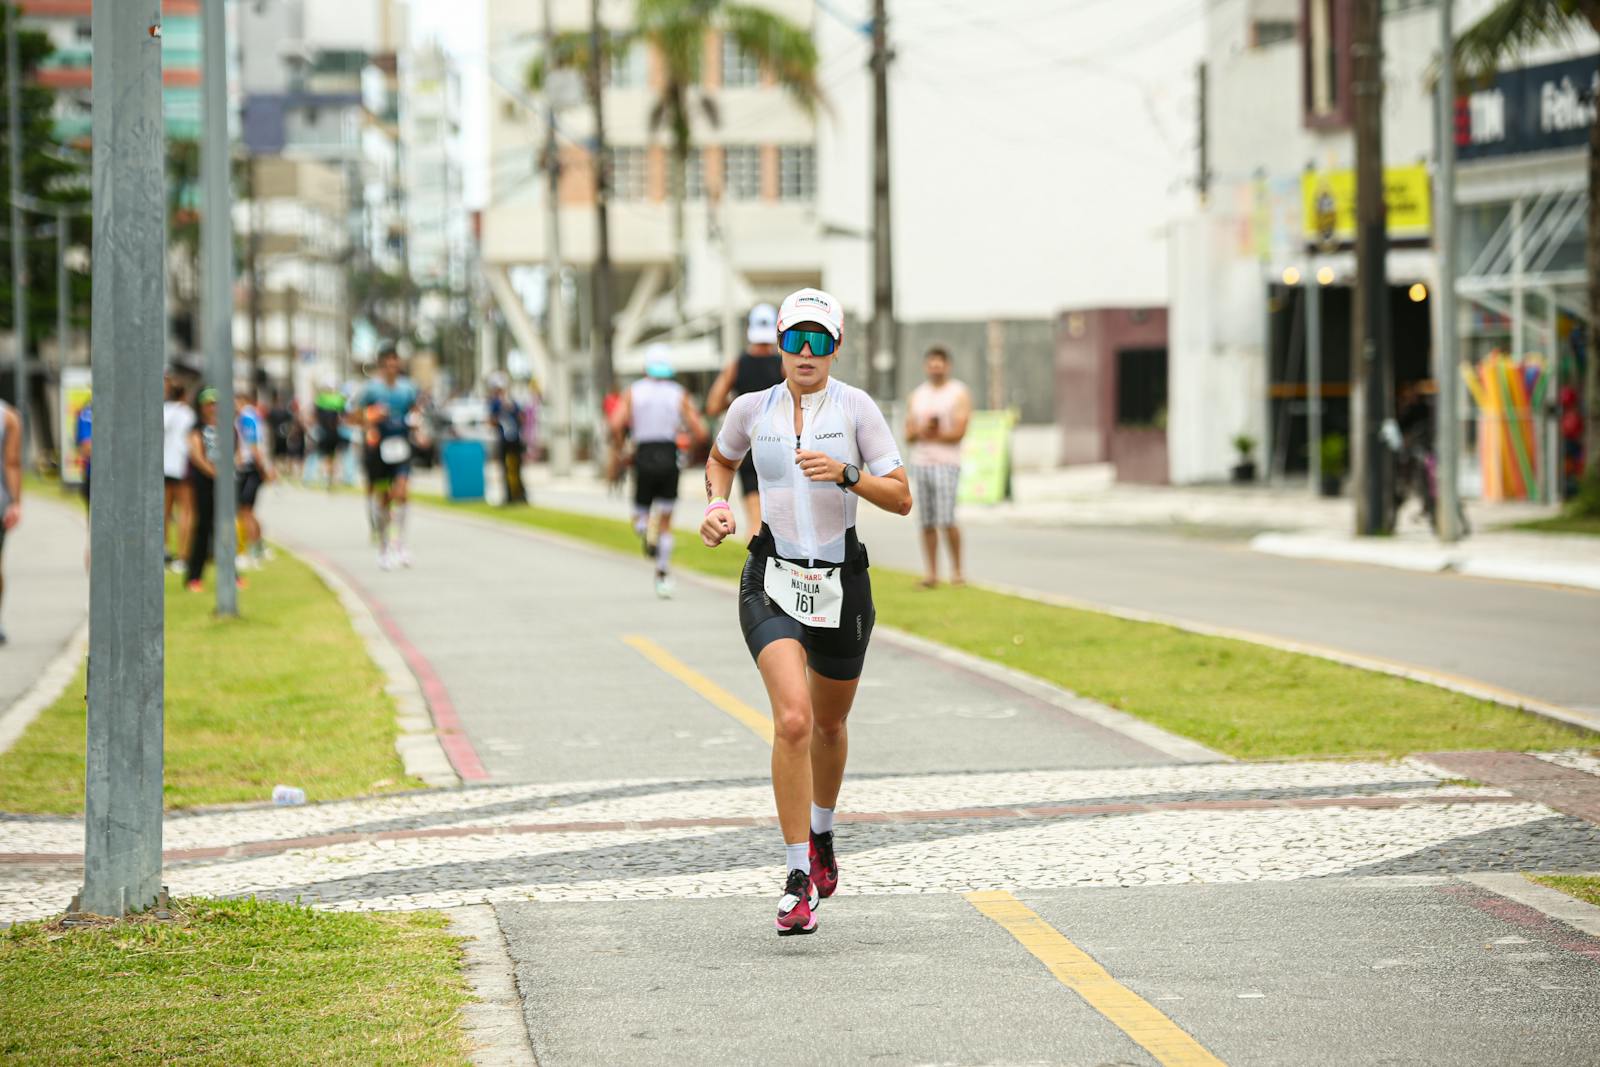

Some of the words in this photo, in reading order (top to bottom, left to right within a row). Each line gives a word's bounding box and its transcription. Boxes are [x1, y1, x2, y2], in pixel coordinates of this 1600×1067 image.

[756, 435, 781, 443] CARBON
[804, 573, 823, 581] HARD
[791, 578, 821, 594] NATALIA
[795, 592, 814, 614] 161
